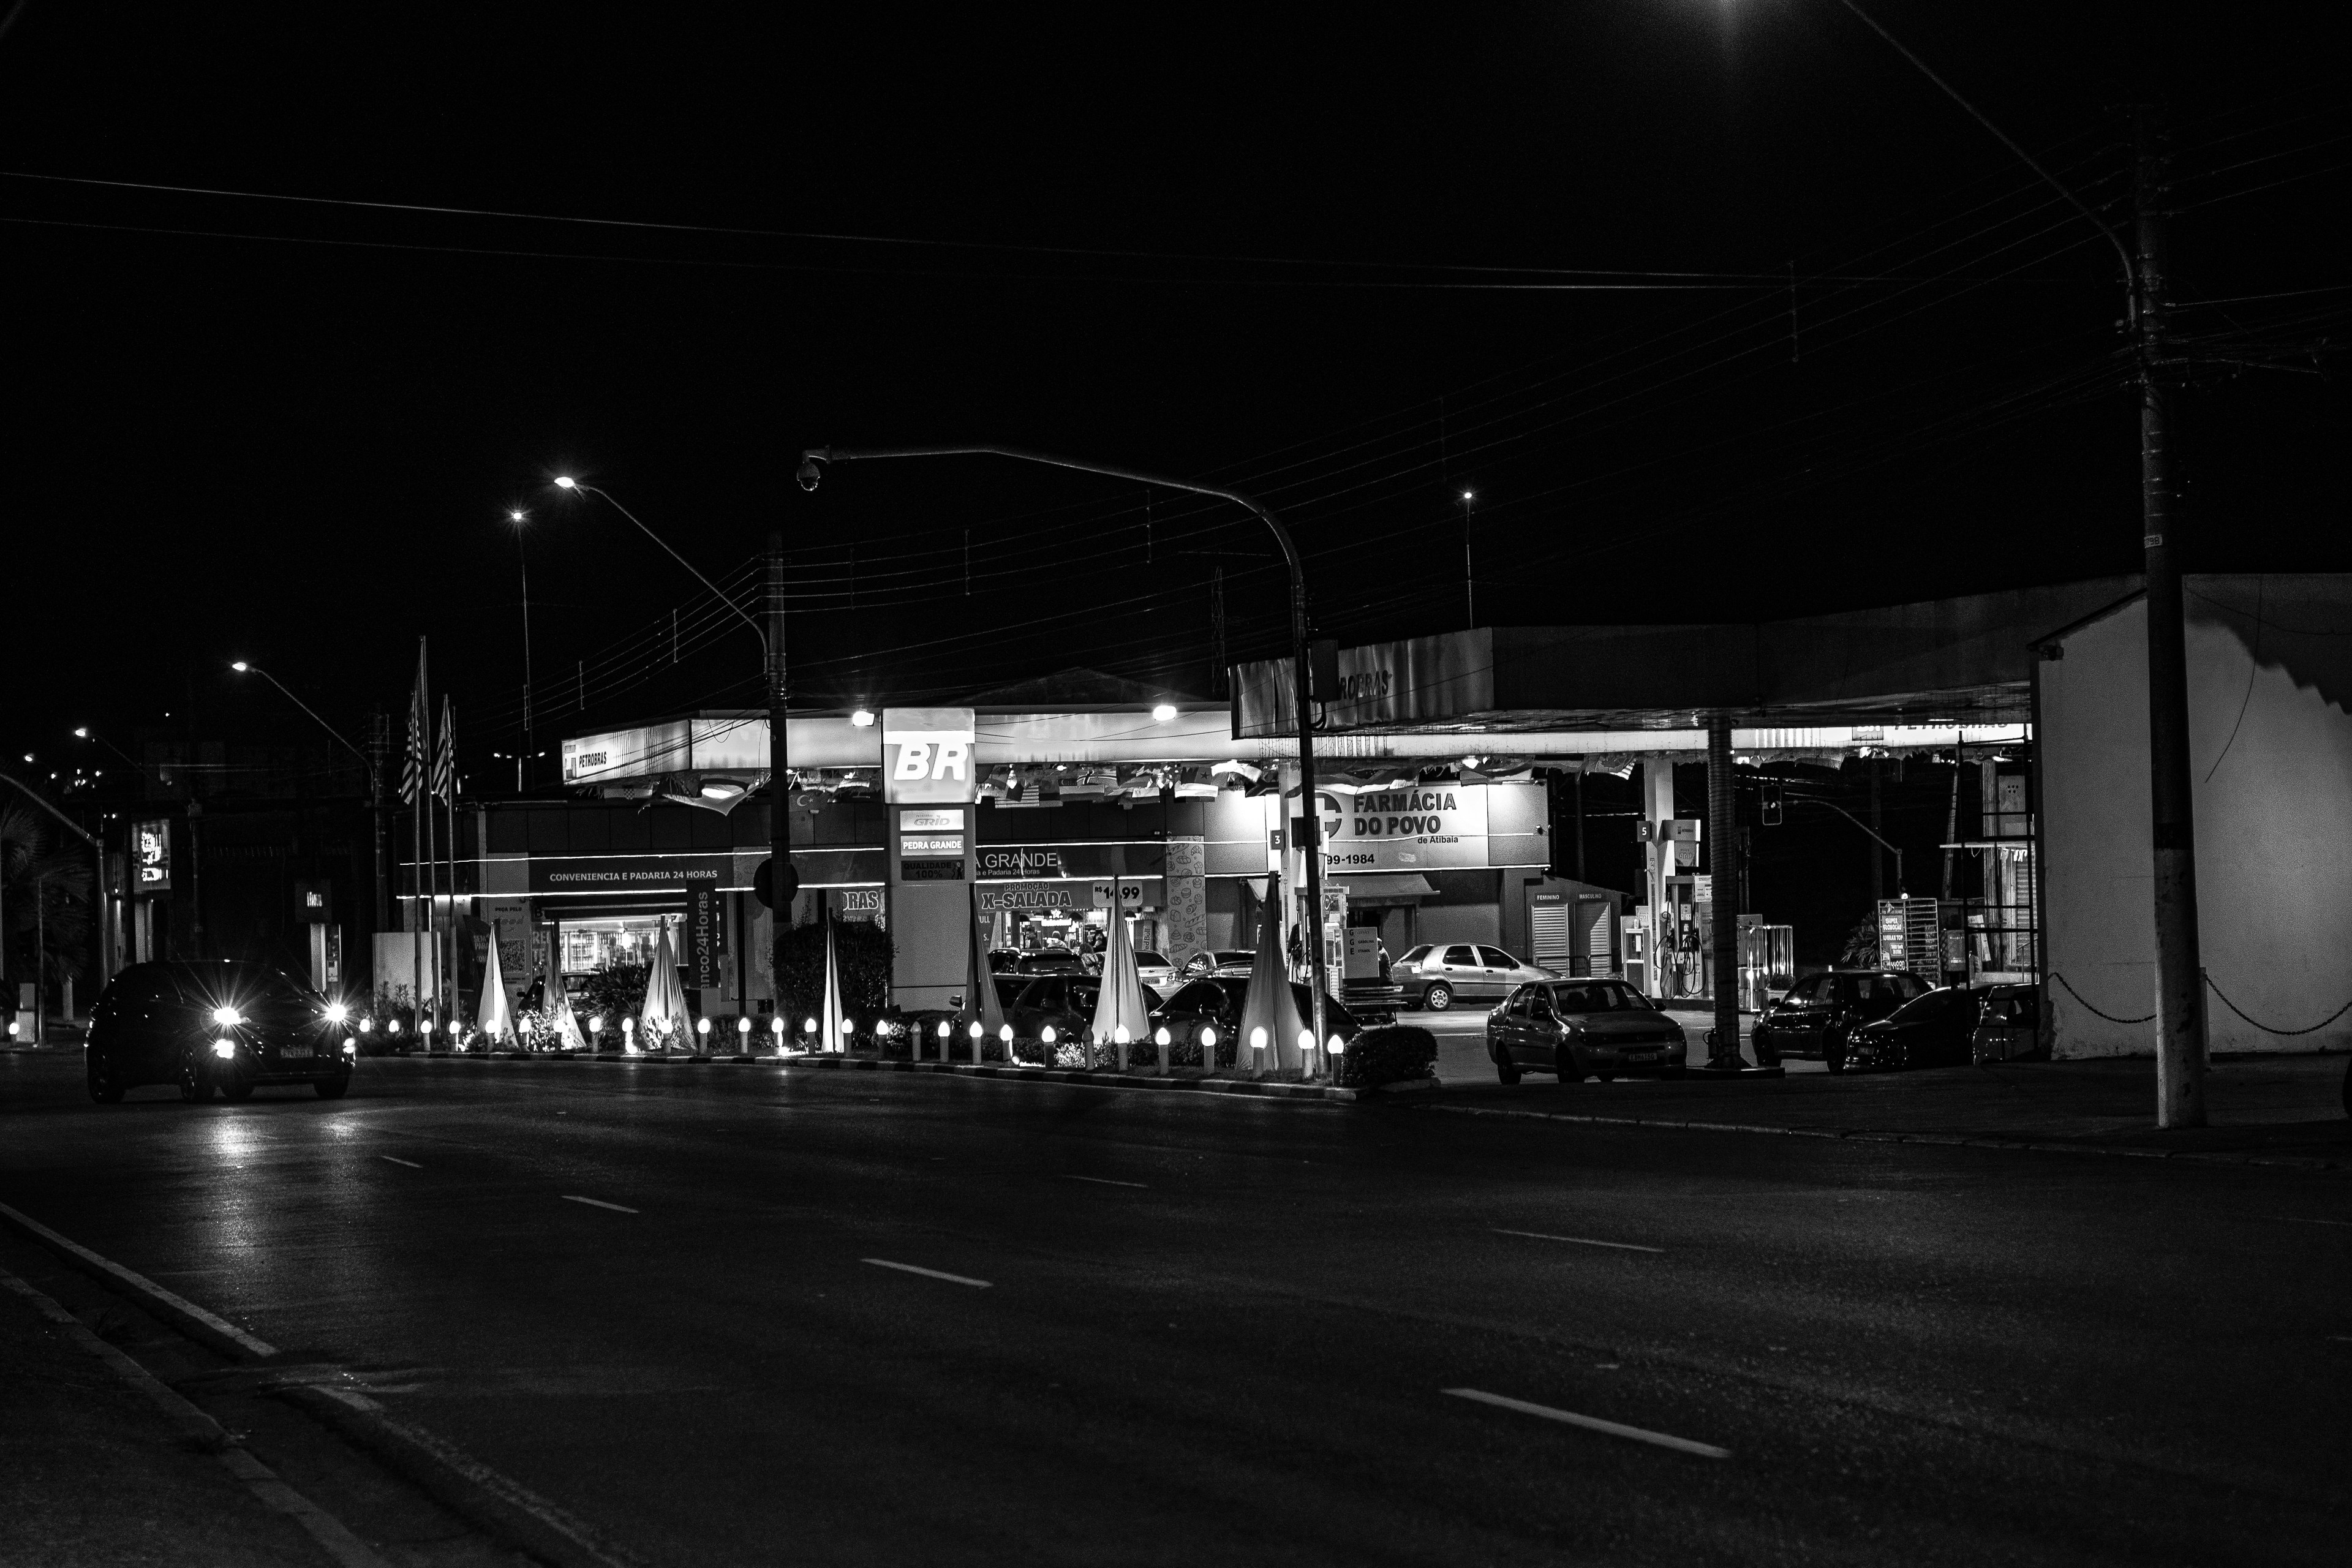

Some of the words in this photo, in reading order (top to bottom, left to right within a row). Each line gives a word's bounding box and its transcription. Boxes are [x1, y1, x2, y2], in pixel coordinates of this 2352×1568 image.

[1340, 670, 1389, 699] ROBRAS
[579, 751, 607, 768] PETROBRAS
[893, 742, 969, 780] BR
[1354, 790, 1457, 813] FARMÁCIA
[1354, 816, 1382, 835] DO
[1387, 815, 1441, 835] POVO
[1642, 827, 1647, 835] 5
[903, 841, 929, 850] PEDRA
[930, 840, 962, 849] GRANDE
[1274, 835, 1281, 844] 3
[1429, 835, 1458, 844] Atibaia
[985, 853, 1057, 868] GRANDE
[1327, 854, 1375, 865] 99-1984
[550, 872, 620, 881] CONVENIENCIA
[630, 872, 671, 880] PADARIA
[916, 870, 943, 879] 100%
[1005, 883, 1050, 891] PROMOÇÃO
[981, 891, 1072, 910] X-SALADA
